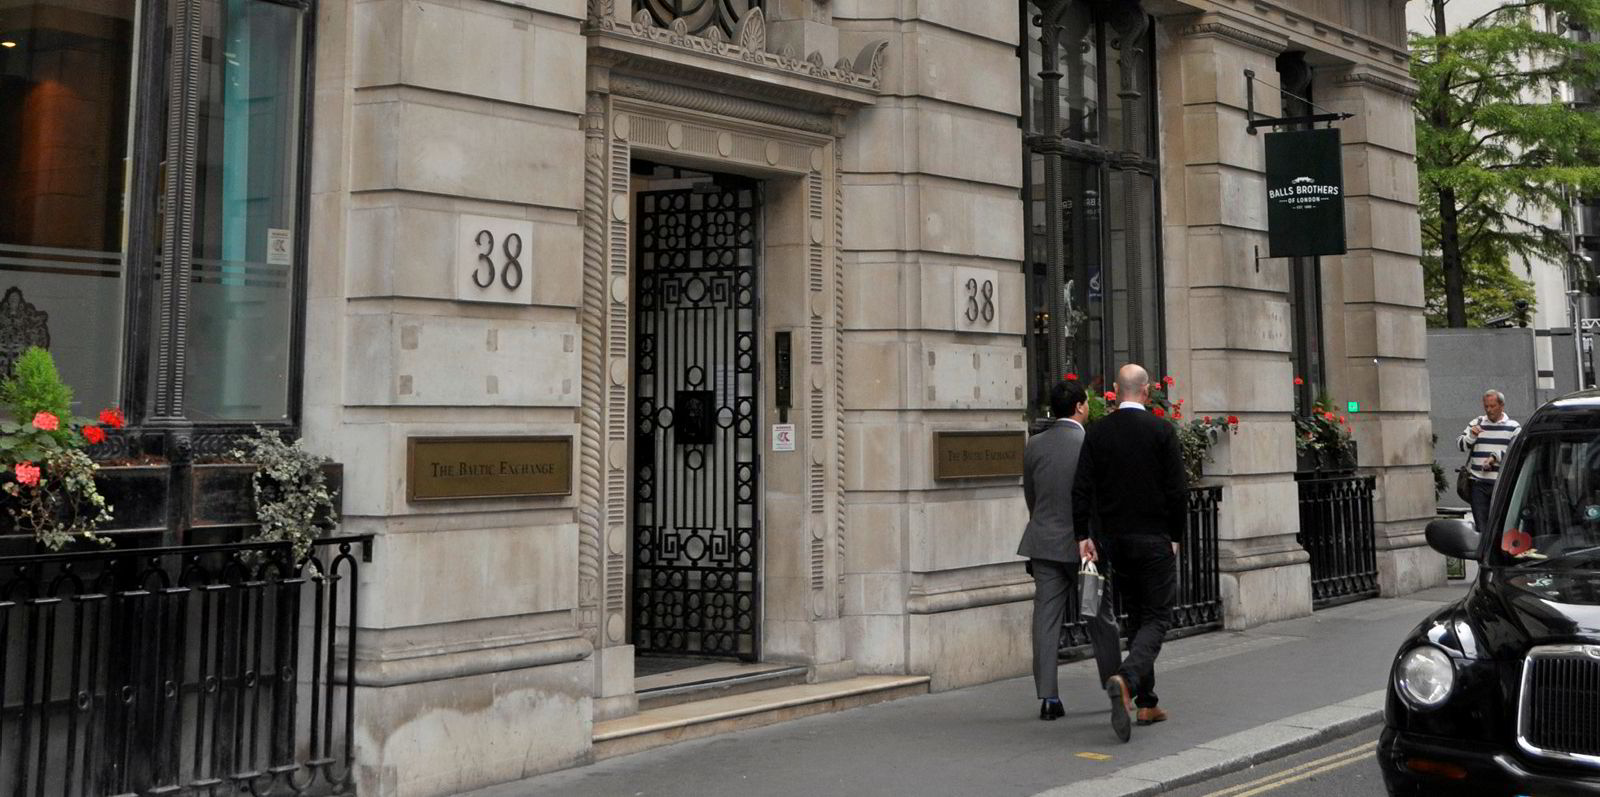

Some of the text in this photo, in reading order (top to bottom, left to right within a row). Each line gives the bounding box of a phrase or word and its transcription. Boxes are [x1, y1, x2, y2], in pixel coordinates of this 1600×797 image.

[1269, 185, 1339, 198] BALLS BROTHERS
[472, 230, 523, 291] 38
[965, 278, 994, 322] 38
[431, 461, 555, 477] THE BALTIC EXCHANGE
